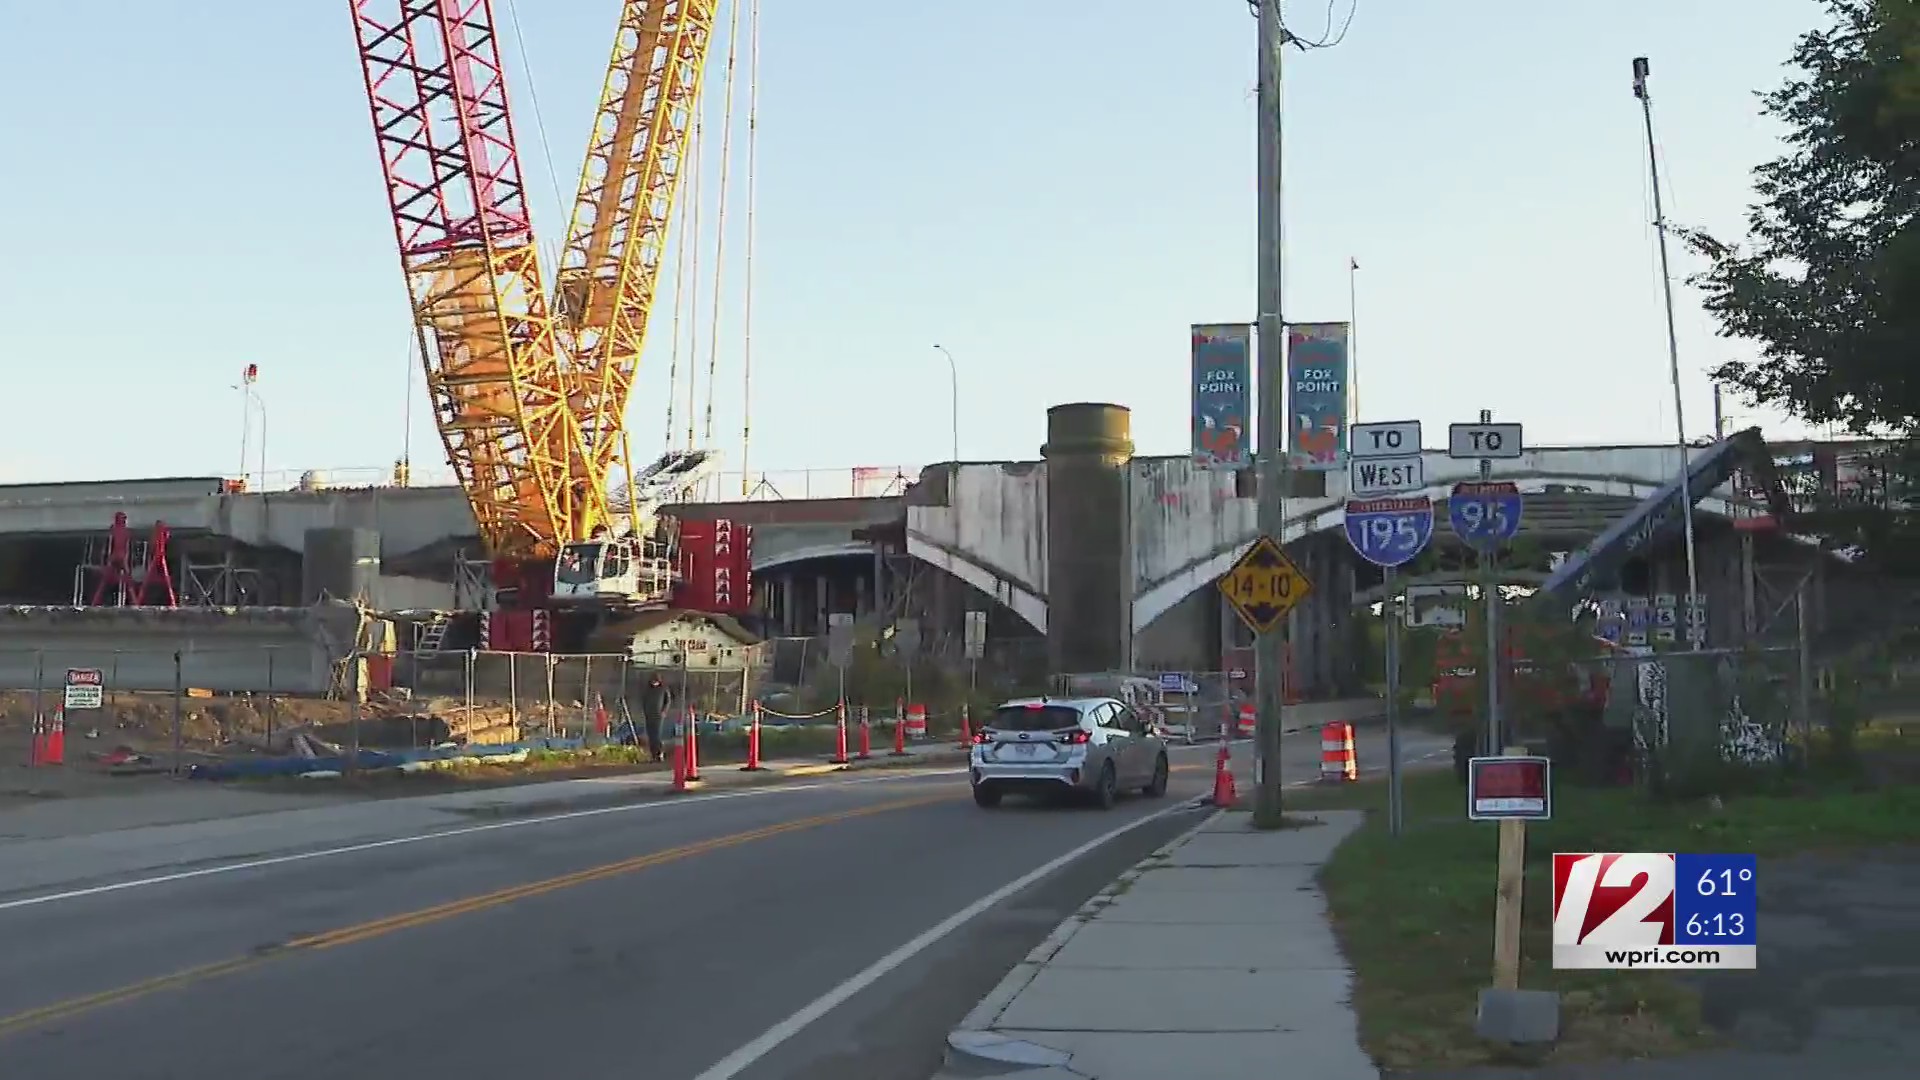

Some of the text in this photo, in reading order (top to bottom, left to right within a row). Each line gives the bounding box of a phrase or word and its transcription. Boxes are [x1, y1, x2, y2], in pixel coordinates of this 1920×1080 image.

[1207, 370, 1235, 381] FOX
[1304, 369, 1332, 380] FOX
[1199, 382, 1242, 393] POINT
[1296, 381, 1340, 393] POINT
[1369, 430, 1402, 449] TO
[1468, 431, 1502, 451] TO
[1359, 464, 1414, 488] WEST
[1461, 502, 1508, 534] 95
[1359, 516, 1419, 551] 195
